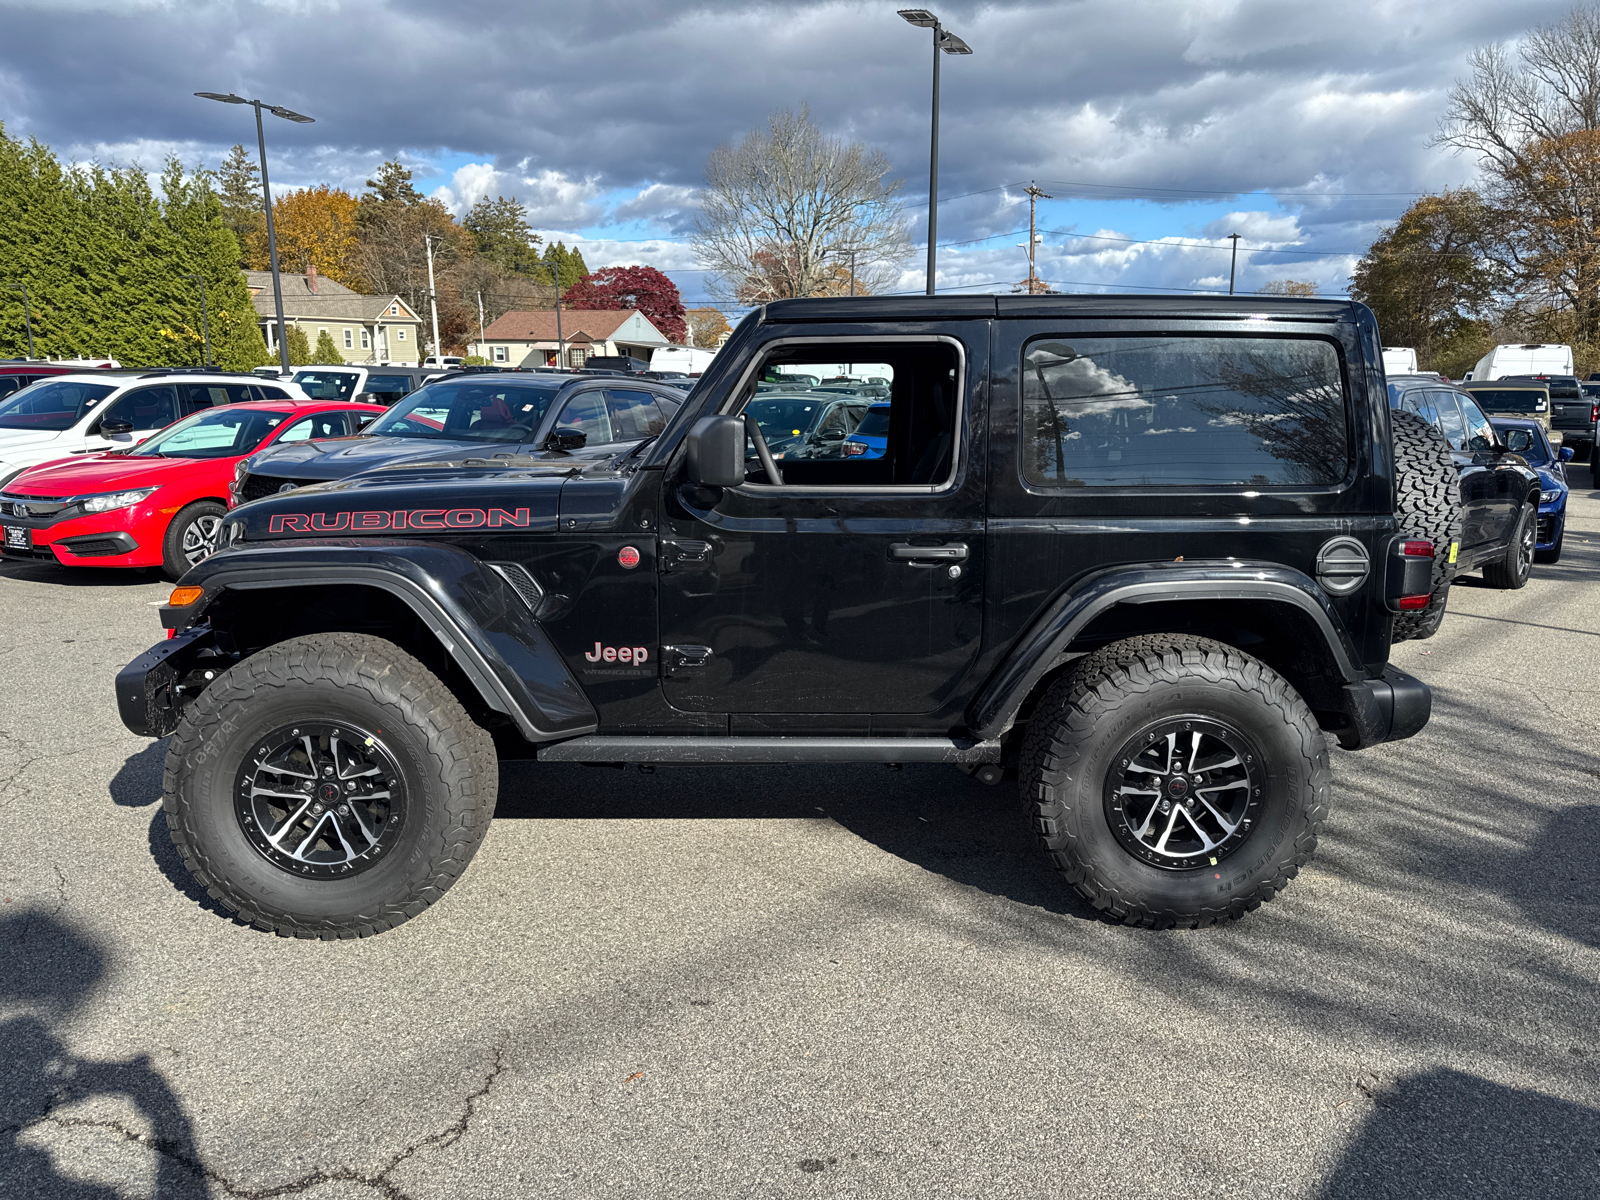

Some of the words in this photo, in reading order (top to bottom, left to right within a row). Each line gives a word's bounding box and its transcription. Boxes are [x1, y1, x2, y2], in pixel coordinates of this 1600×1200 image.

[269, 508, 530, 533] RUBICON
[584, 641, 649, 667] Jeep
[582, 668, 641, 676] WRANGLER
